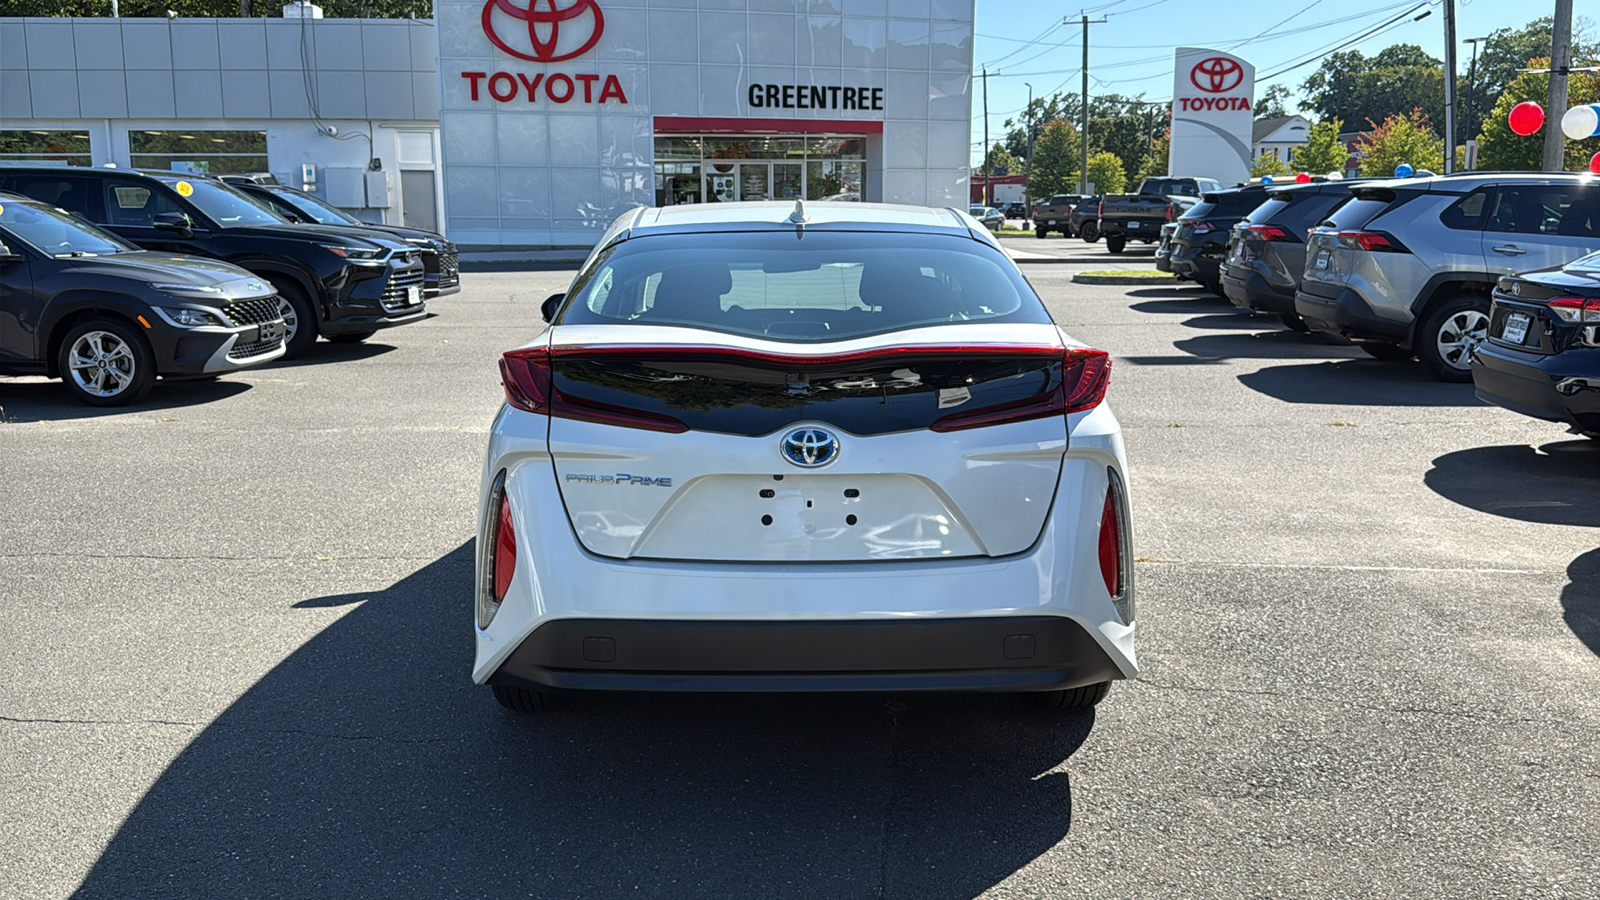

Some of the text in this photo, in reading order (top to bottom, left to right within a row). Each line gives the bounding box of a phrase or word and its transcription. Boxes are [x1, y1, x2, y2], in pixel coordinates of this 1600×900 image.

[461, 71, 628, 104] TOYOTA
[748, 83, 884, 111] GREENTREE
[1179, 97, 1251, 112] TOYOTA
